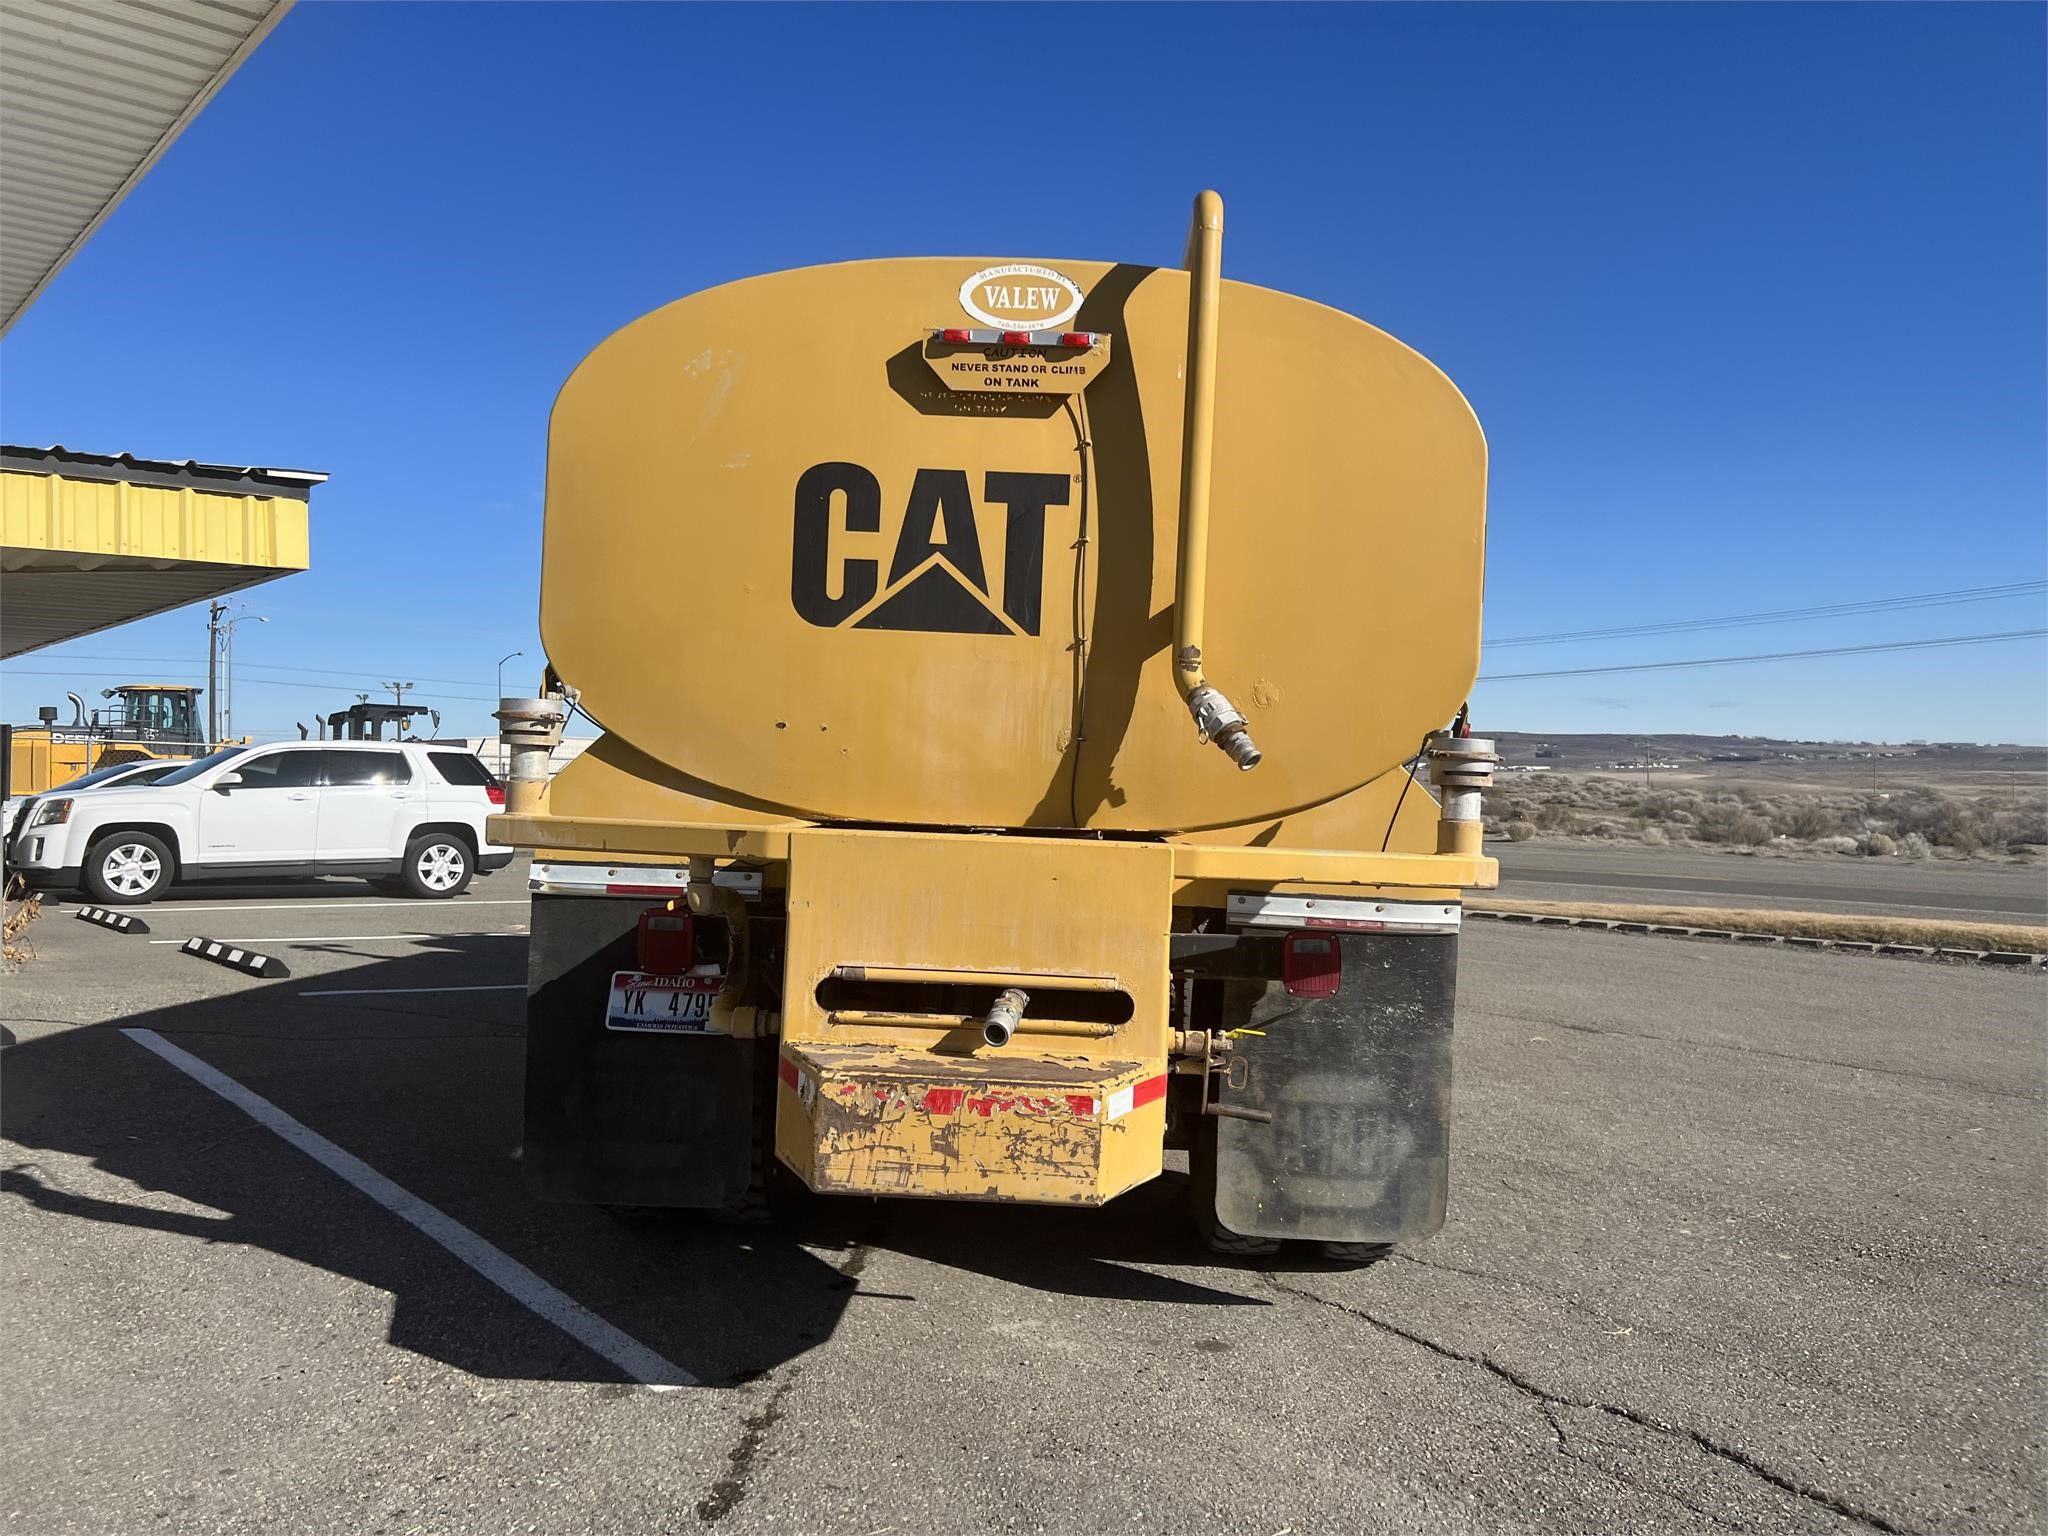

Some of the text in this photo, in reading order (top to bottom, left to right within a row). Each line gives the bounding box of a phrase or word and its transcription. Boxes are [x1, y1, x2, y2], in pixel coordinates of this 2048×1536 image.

[983, 285, 1060, 311] VALEW
[983, 347, 1047, 359] CAUTION
[951, 363, 1086, 375] NEVER STAND OR CLIMB
[984, 377, 1039, 388] ON TANK
[791, 461, 1071, 637] CAT
[653, 977, 695, 988] IDAHO
[624, 989, 647, 1015] YK
